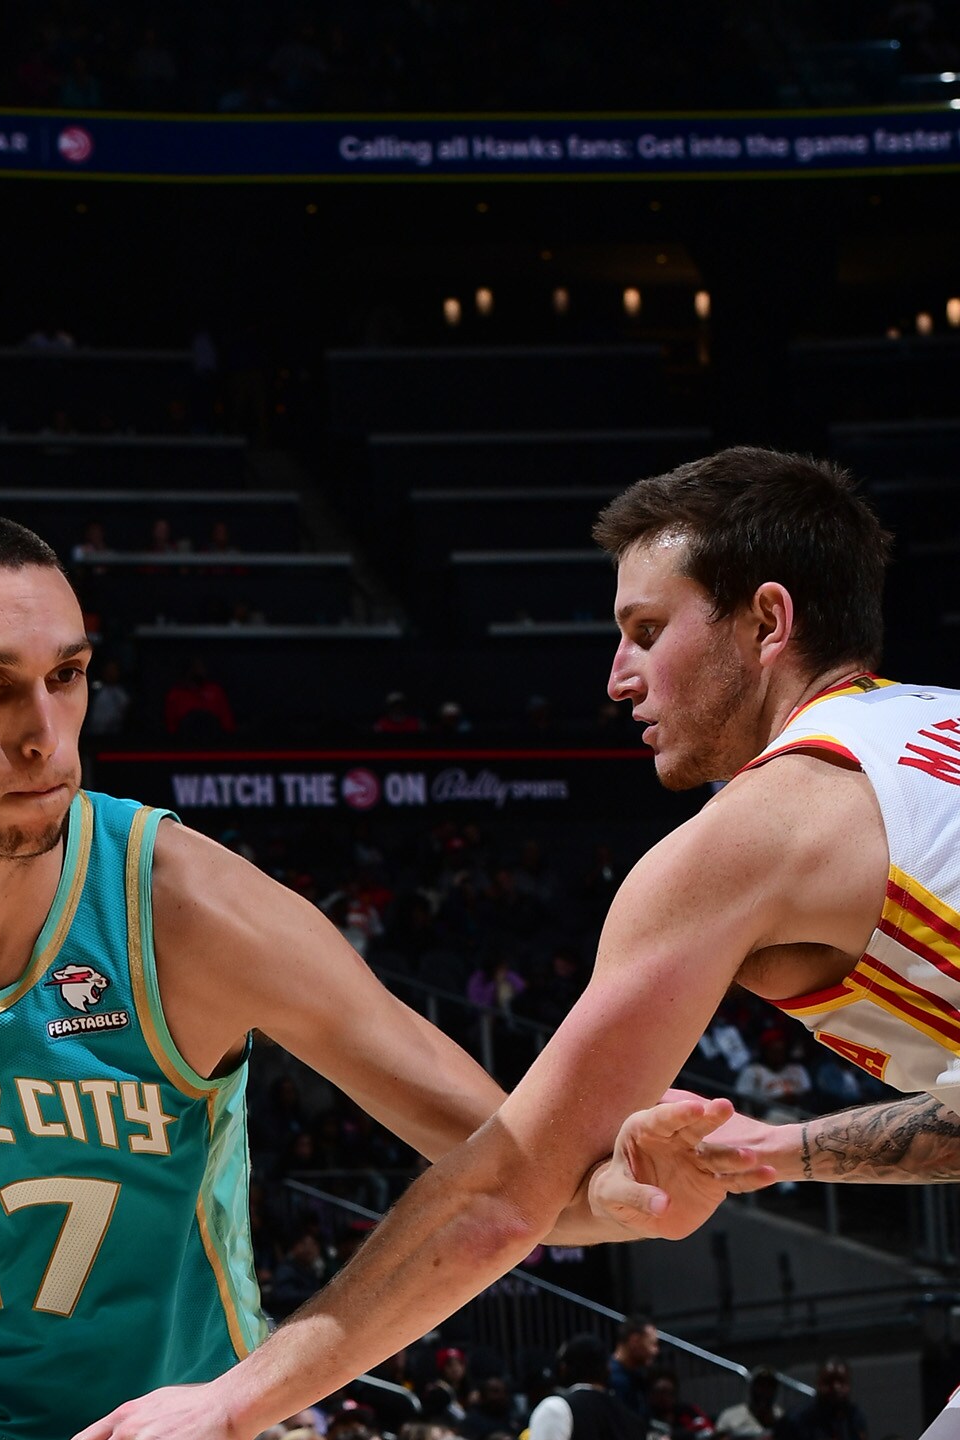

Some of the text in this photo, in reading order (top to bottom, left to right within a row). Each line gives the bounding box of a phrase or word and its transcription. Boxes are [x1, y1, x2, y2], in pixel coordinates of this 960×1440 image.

[339, 127, 952, 166] Calling all Hawks fans: Get into the game faster
[171, 772, 276, 807] WATCH
[280, 772, 338, 807] THE
[384, 771, 428, 807] ON
[510, 779, 570, 801] SPORTS
[48, 1012, 129, 1036] FEASTABLES
[14, 1077, 179, 1156] CITY
